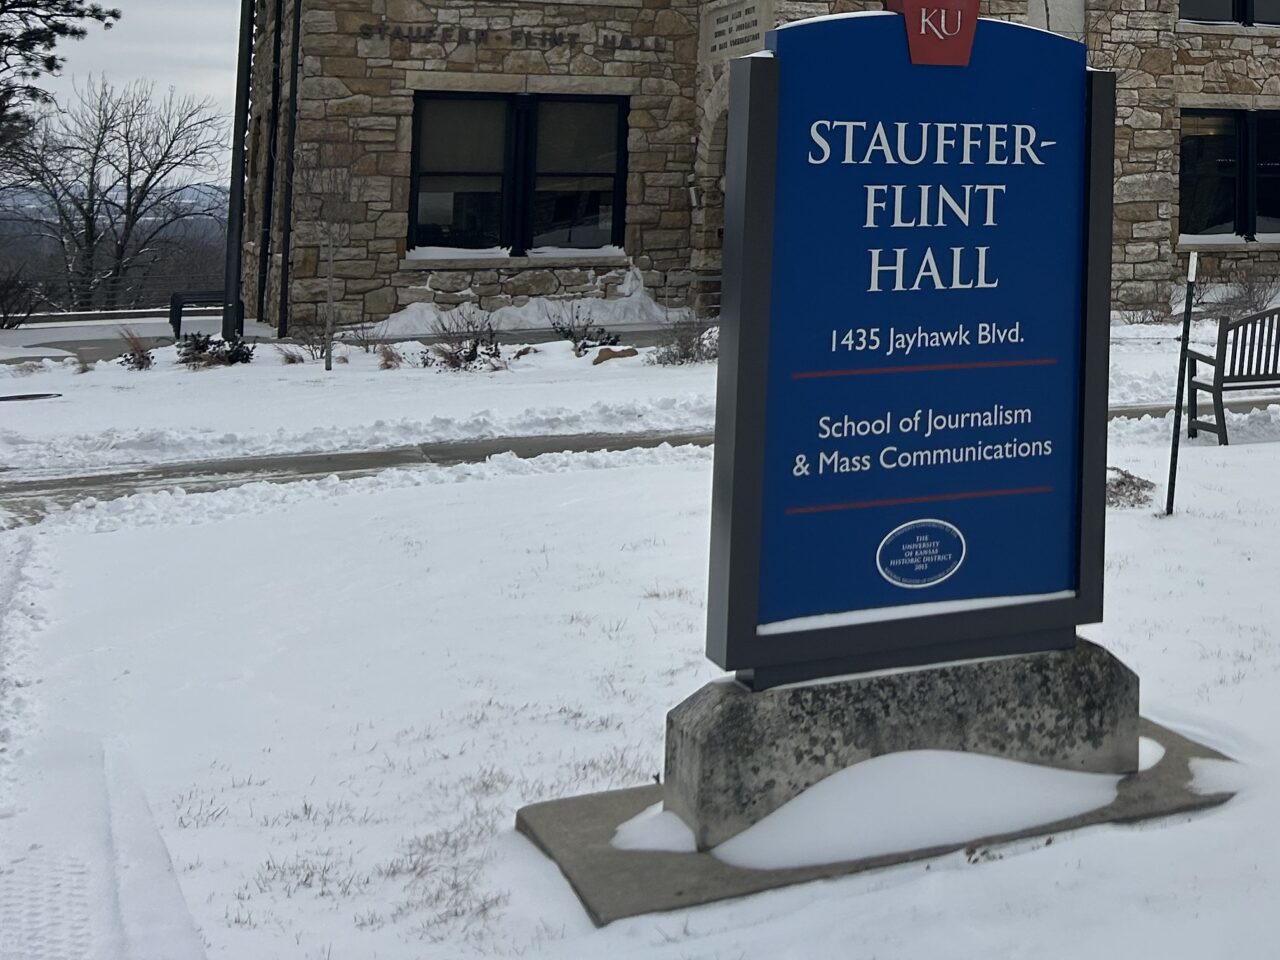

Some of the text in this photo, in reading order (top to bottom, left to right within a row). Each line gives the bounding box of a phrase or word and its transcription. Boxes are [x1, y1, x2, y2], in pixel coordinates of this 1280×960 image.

[920, 7, 962, 39] KU
[808, 120, 1057, 166] STAUFFER-
[862, 184, 1006, 228] FLINT
[866, 246, 999, 292] HALL
[830, 321, 1025, 356] 1435 Jayhawk Blvd.
[818, 404, 1032, 439] School of Journalism
[792, 439, 1053, 477] & Mass Communications
[889, 553, 953, 567] HISTORIC DISTRICT
[902, 540, 940, 551] UNIVERSITY
